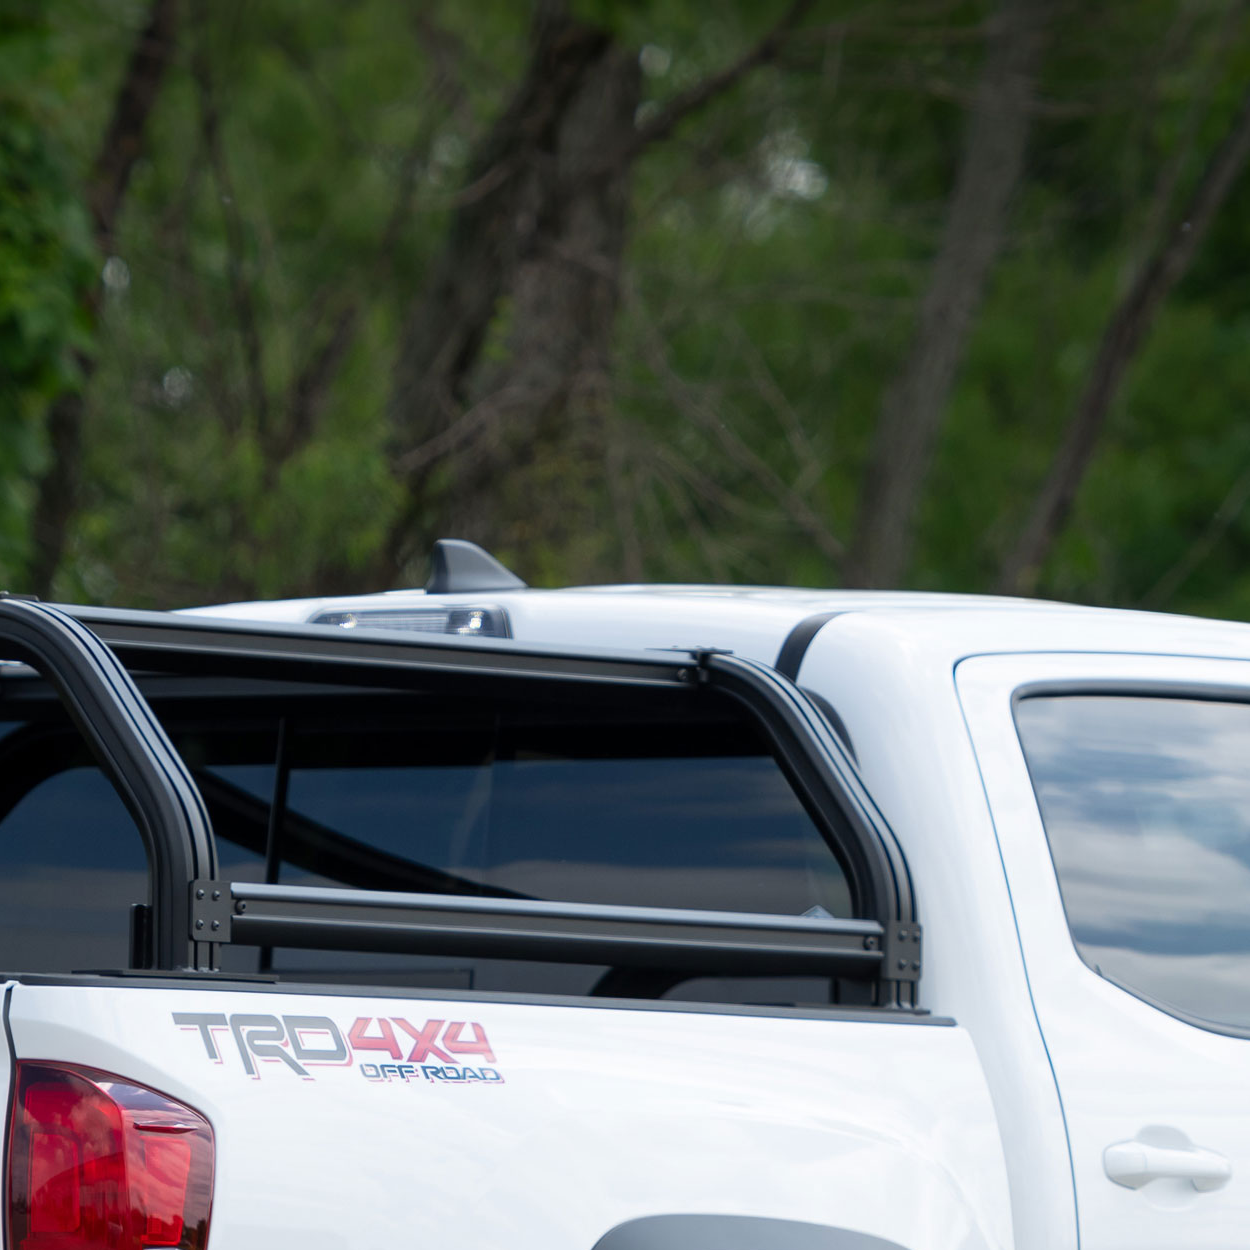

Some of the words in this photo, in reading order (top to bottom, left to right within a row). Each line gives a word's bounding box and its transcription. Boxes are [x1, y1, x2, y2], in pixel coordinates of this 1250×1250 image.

[171, 1012, 353, 1080] TRD
[359, 1064, 419, 1082] OFF
[424, 1066, 504, 1084] ROAD
